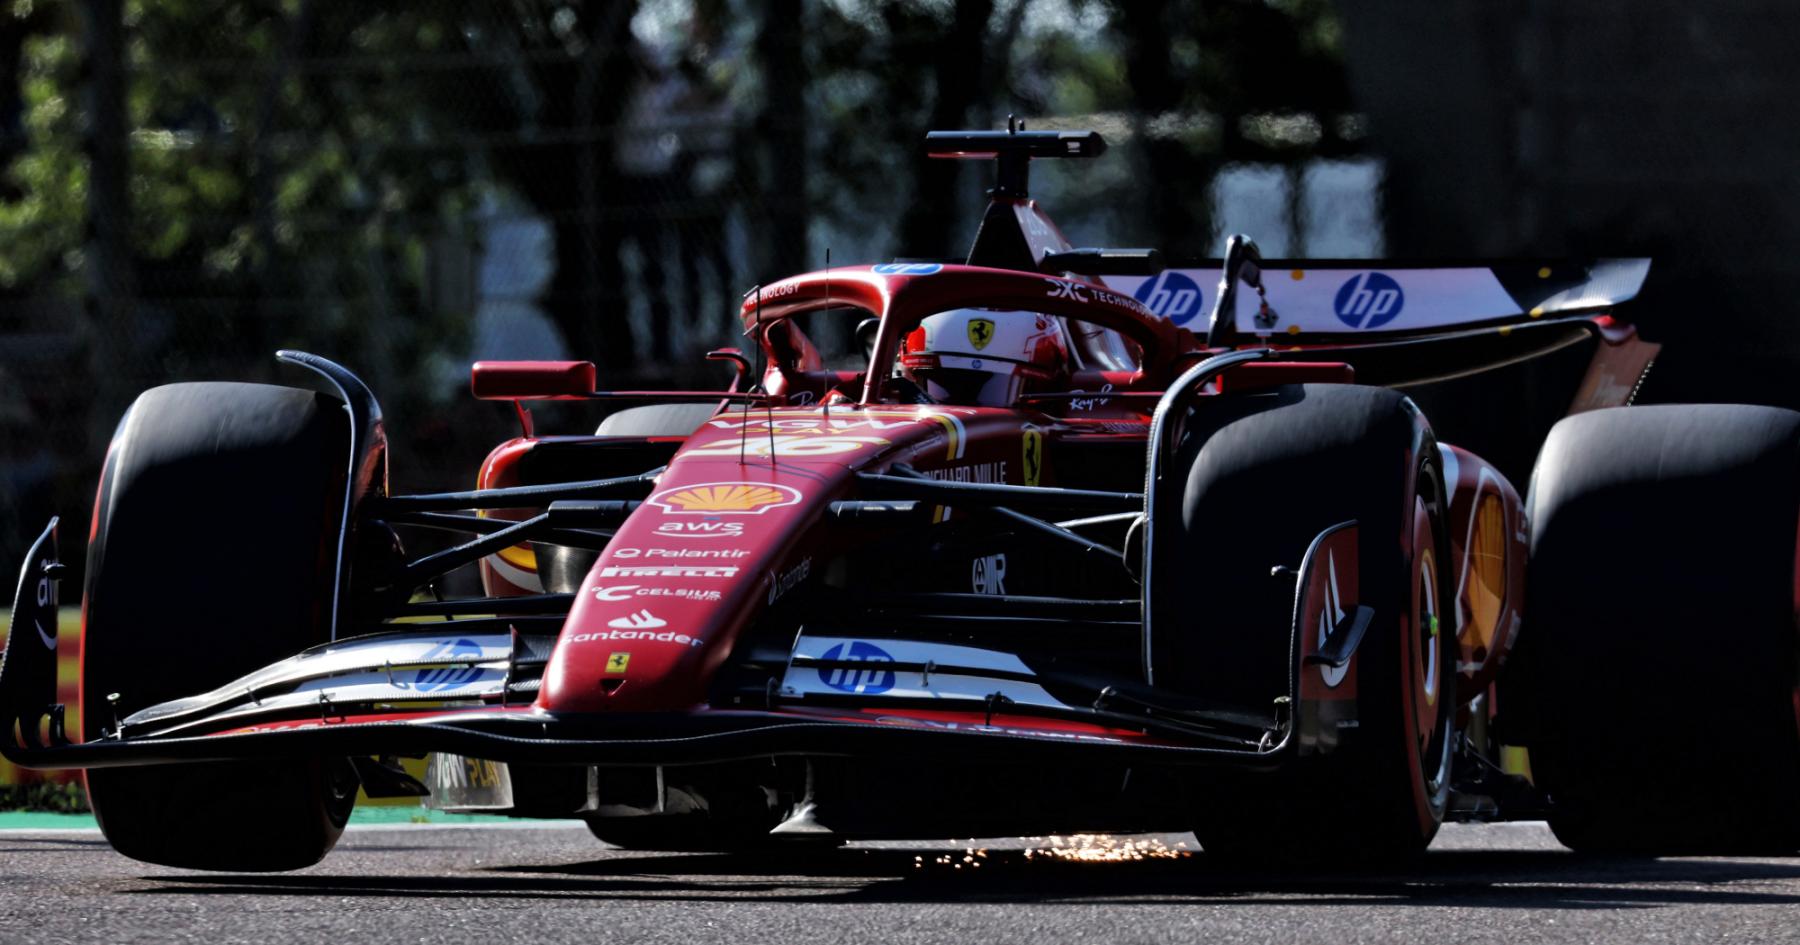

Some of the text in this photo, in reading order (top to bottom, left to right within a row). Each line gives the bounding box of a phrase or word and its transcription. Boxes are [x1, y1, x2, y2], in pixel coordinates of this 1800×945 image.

[1140, 272, 1199, 323] hp
[1339, 272, 1400, 328] hp
[709, 418, 919, 430] VGW
[658, 522, 745, 532] aws
[645, 548, 751, 558] Palantir
[600, 566, 740, 577] PIRELLI
[635, 588, 721, 598] CELSIUS
[825, 641, 891, 693] hp
